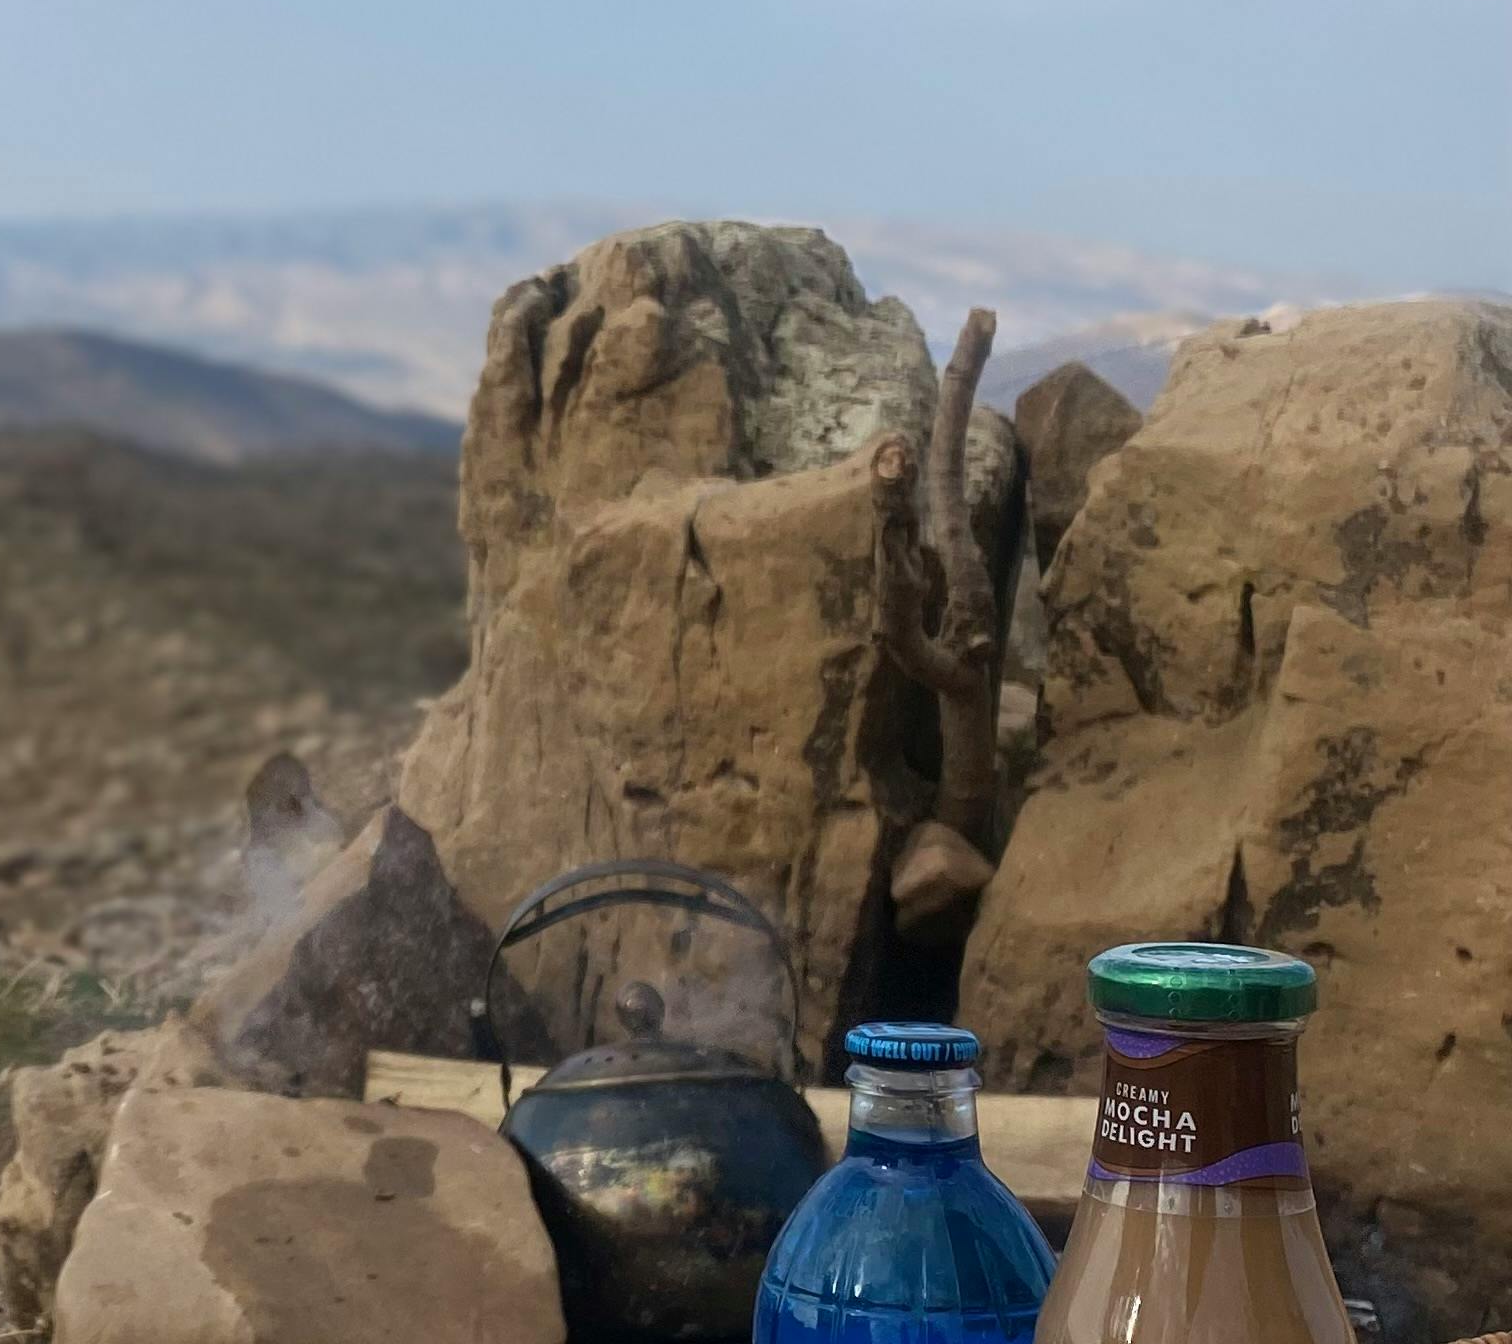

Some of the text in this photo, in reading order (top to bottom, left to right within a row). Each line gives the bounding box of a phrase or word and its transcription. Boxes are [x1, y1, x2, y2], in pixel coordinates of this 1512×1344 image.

[911, 1042, 942, 1062] OUT
[1115, 1081, 1170, 1105] CREAMY
[1103, 1096, 1198, 1132] MOCHA
[1100, 1118, 1197, 1153] DELIGHT
